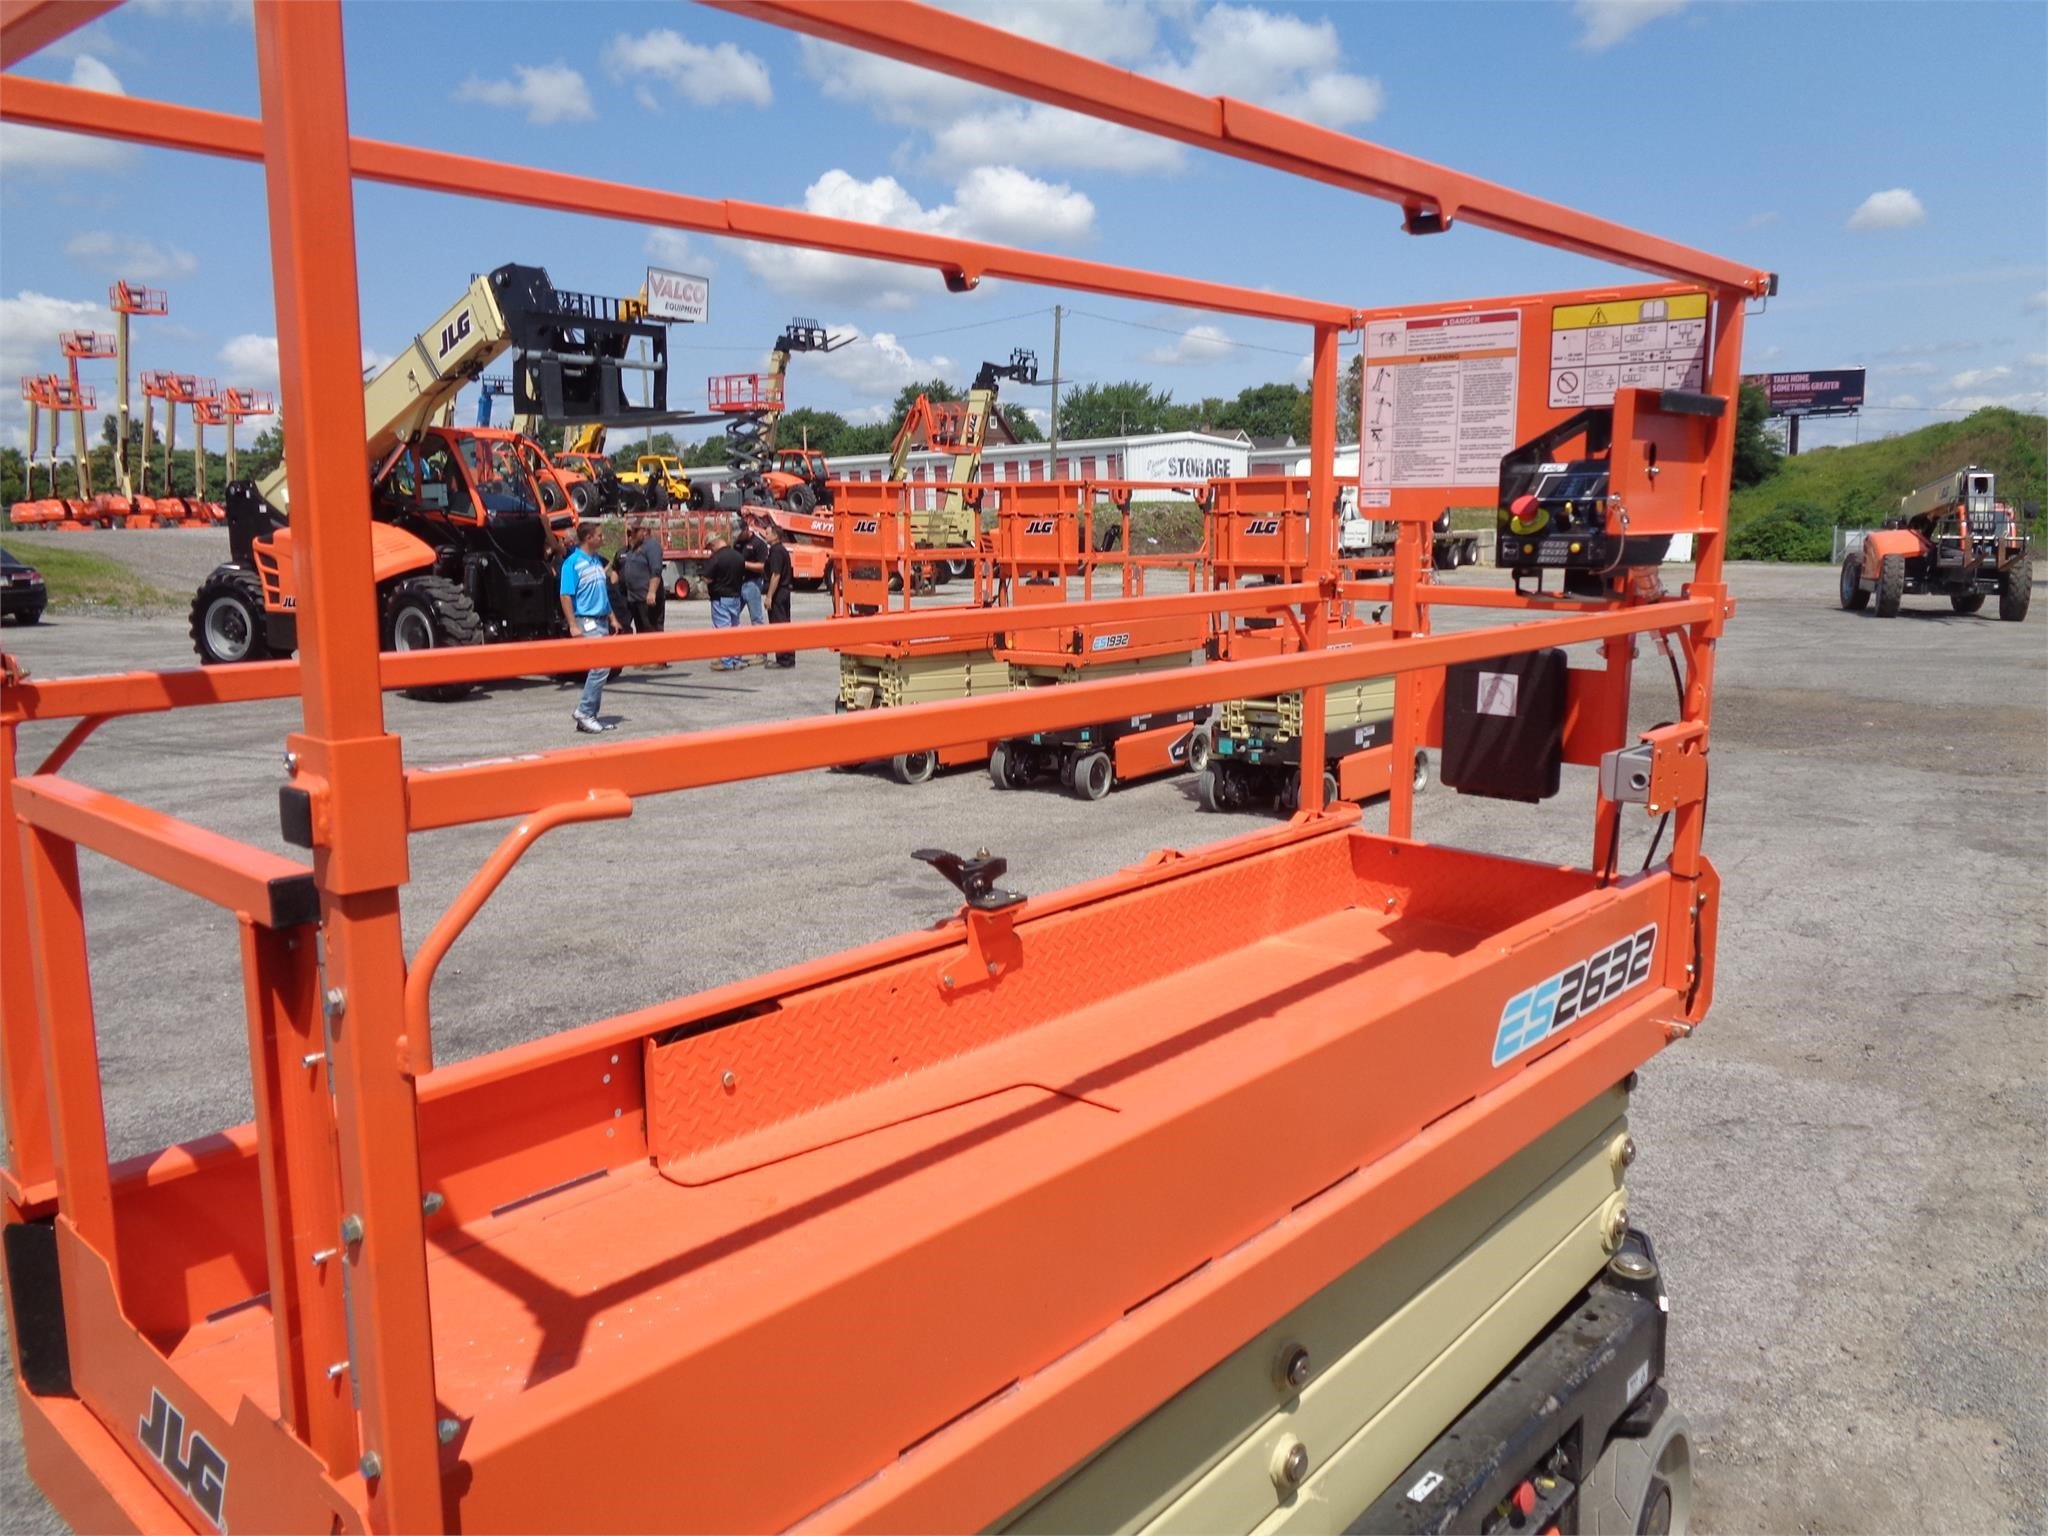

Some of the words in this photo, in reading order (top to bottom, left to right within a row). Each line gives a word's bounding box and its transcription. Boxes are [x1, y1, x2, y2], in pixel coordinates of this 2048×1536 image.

[649, 271, 706, 304] VALCO
[664, 301, 702, 315] EQUIPMENT
[1449, 316, 1481, 325] DANGER
[439, 307, 471, 360] JLG
[1426, 353, 1460, 362] WARNING
[1773, 375, 1790, 383] TAKE
[1791, 374, 1810, 382] HOME
[1772, 382, 1810, 392] SOMETHING
[1811, 381, 1840, 391] GREATER
[1168, 457, 1231, 478] STORAGE
[811, 520, 834, 532] SKYT
[853, 521, 877, 533] JLG
[1025, 521, 1053, 533] JLG
[1245, 520, 1279, 535] JLG
[1494, 926, 1656, 1064] ES2632
[138, 1388, 227, 1528] JLG
